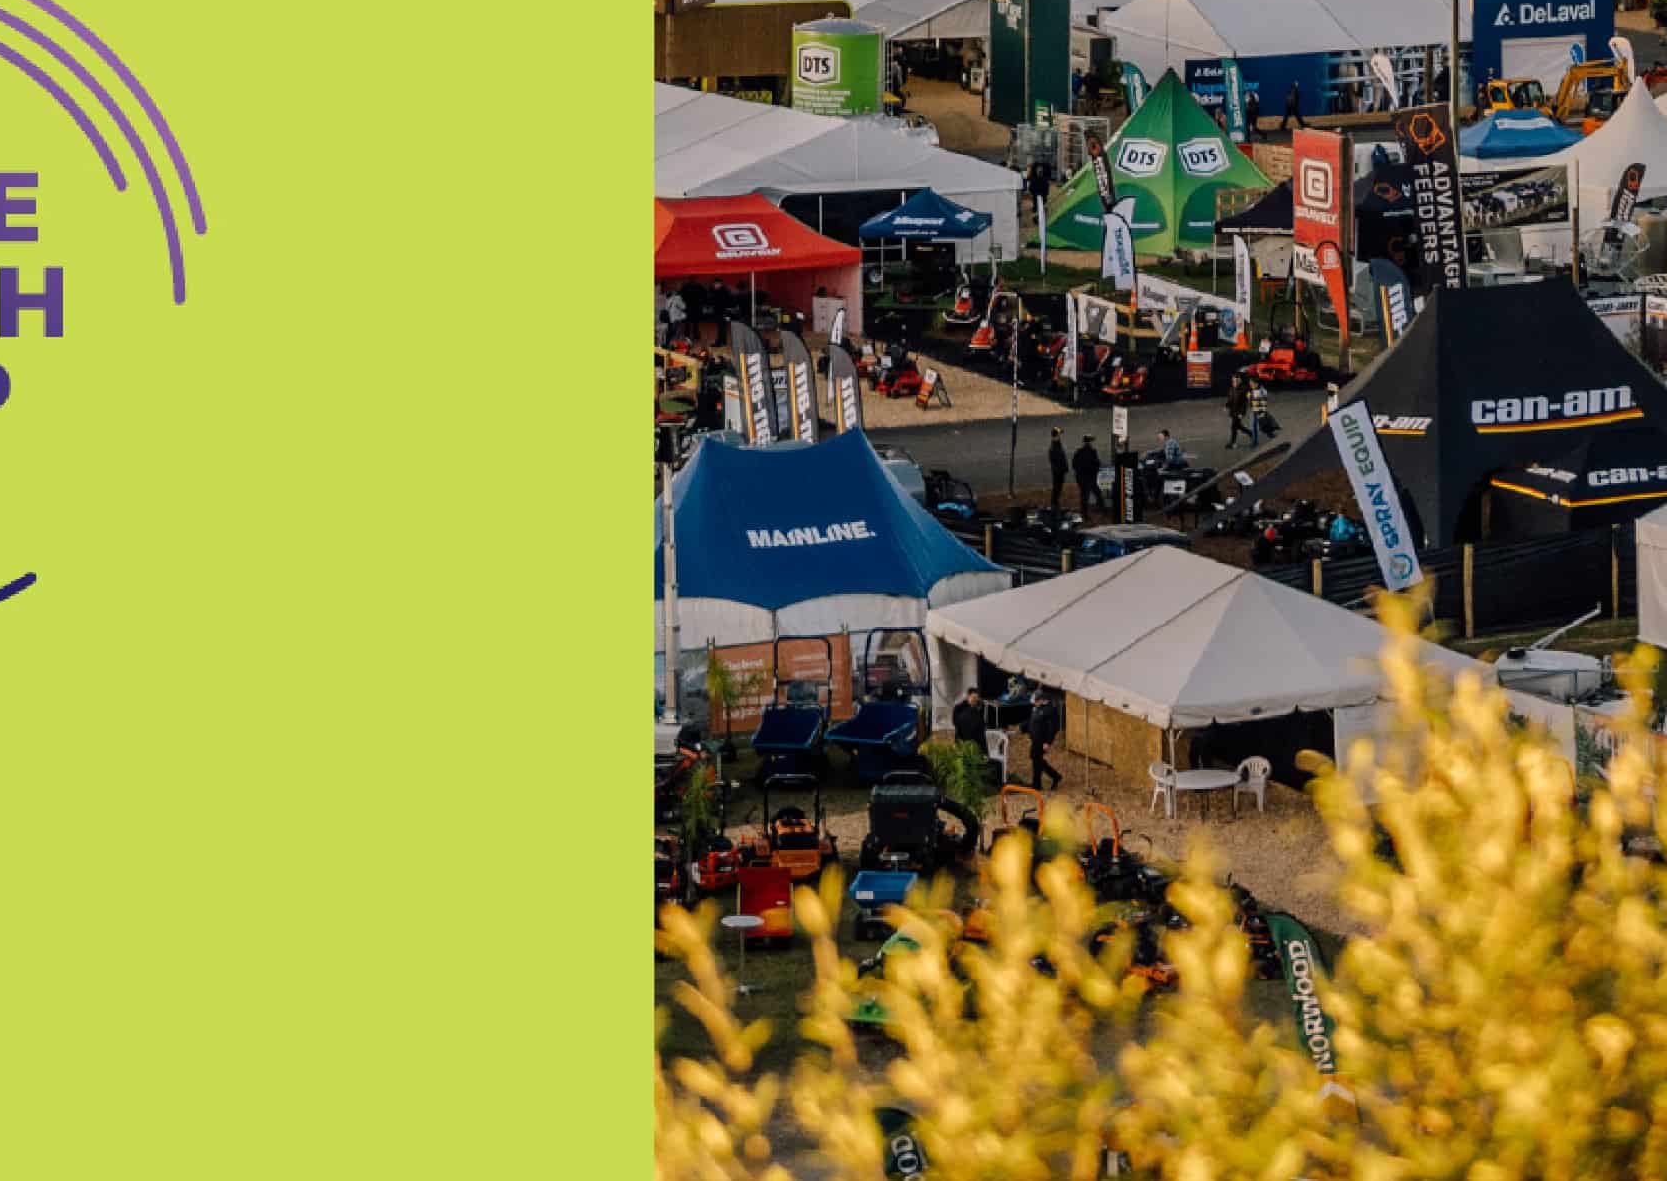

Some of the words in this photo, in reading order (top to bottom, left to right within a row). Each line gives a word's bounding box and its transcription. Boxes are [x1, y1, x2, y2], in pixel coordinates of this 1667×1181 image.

[1519, 0, 1596, 25] DeLaval
[802, 55, 831, 75] DTS
[1127, 149, 1157, 166] DTS
[1187, 148, 1218, 166] DTS
[1414, 163, 1440, 264] FEEDERS
[1431, 159, 1461, 289] ADVANTAGE
[1470, 385, 1635, 425] can-am
[1340, 413, 1376, 477] EQUIP
[1362, 481, 1400, 550] SPRAY
